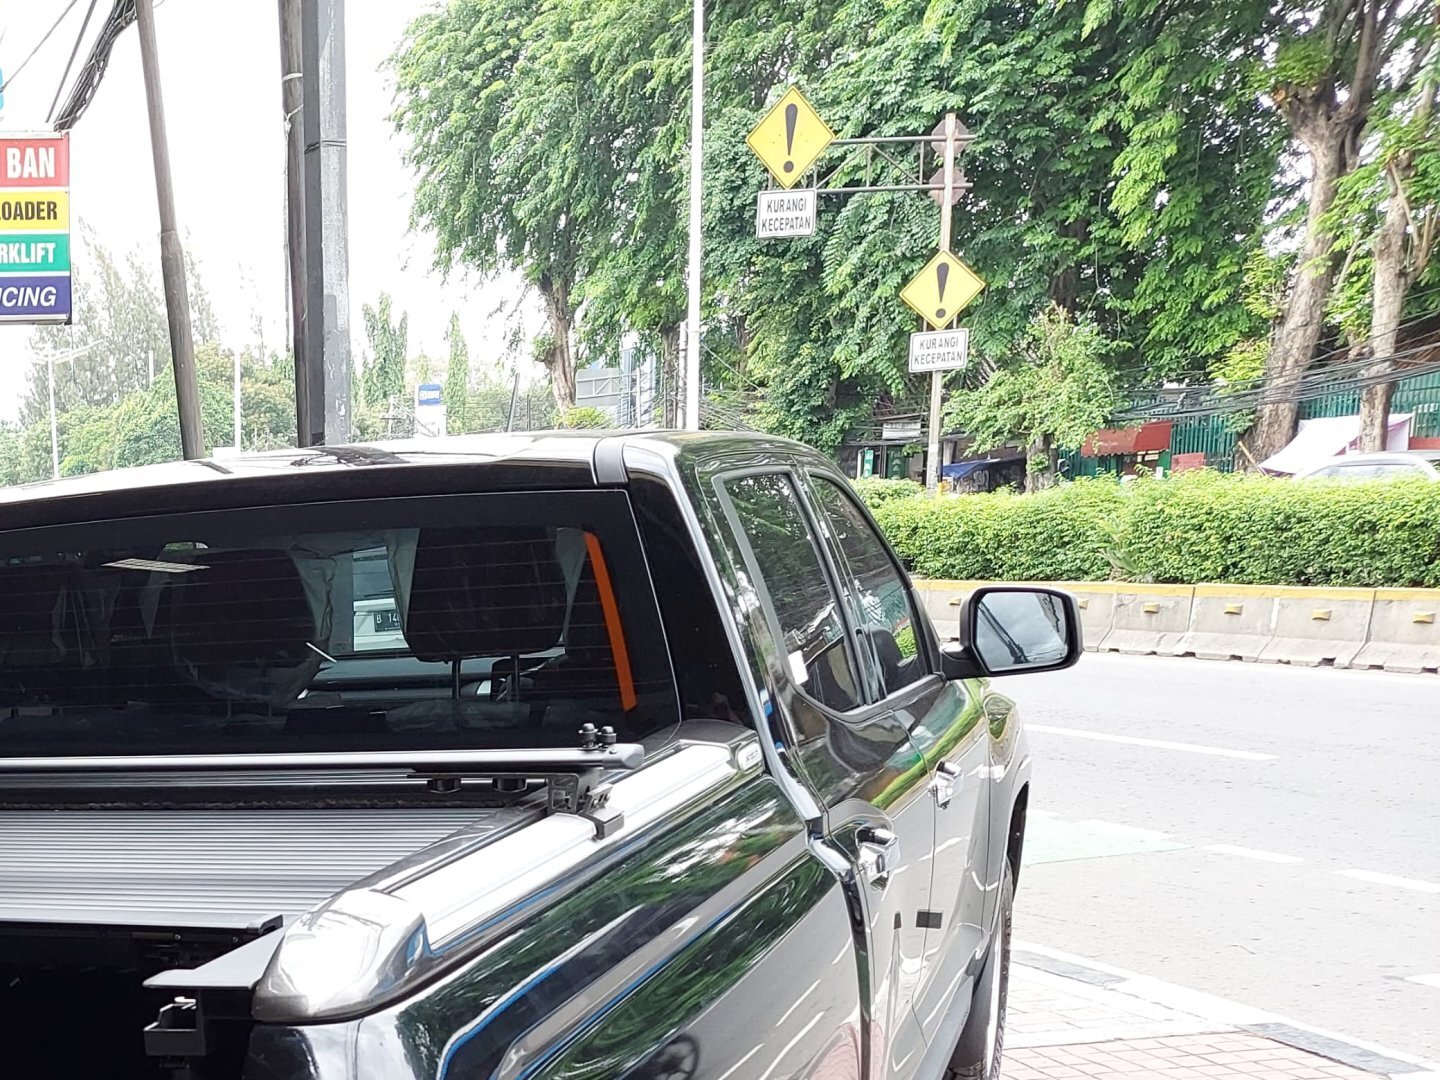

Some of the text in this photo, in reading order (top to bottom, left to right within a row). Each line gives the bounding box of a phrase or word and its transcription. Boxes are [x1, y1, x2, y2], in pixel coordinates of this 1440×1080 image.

[8, 146, 56, 178] BAN
[766, 198, 807, 213] KURANGI
[761, 216, 812, 232] KECEPATAN
[920, 336, 959, 350] KURANGI
[914, 350, 963, 365] KECEPATAN
